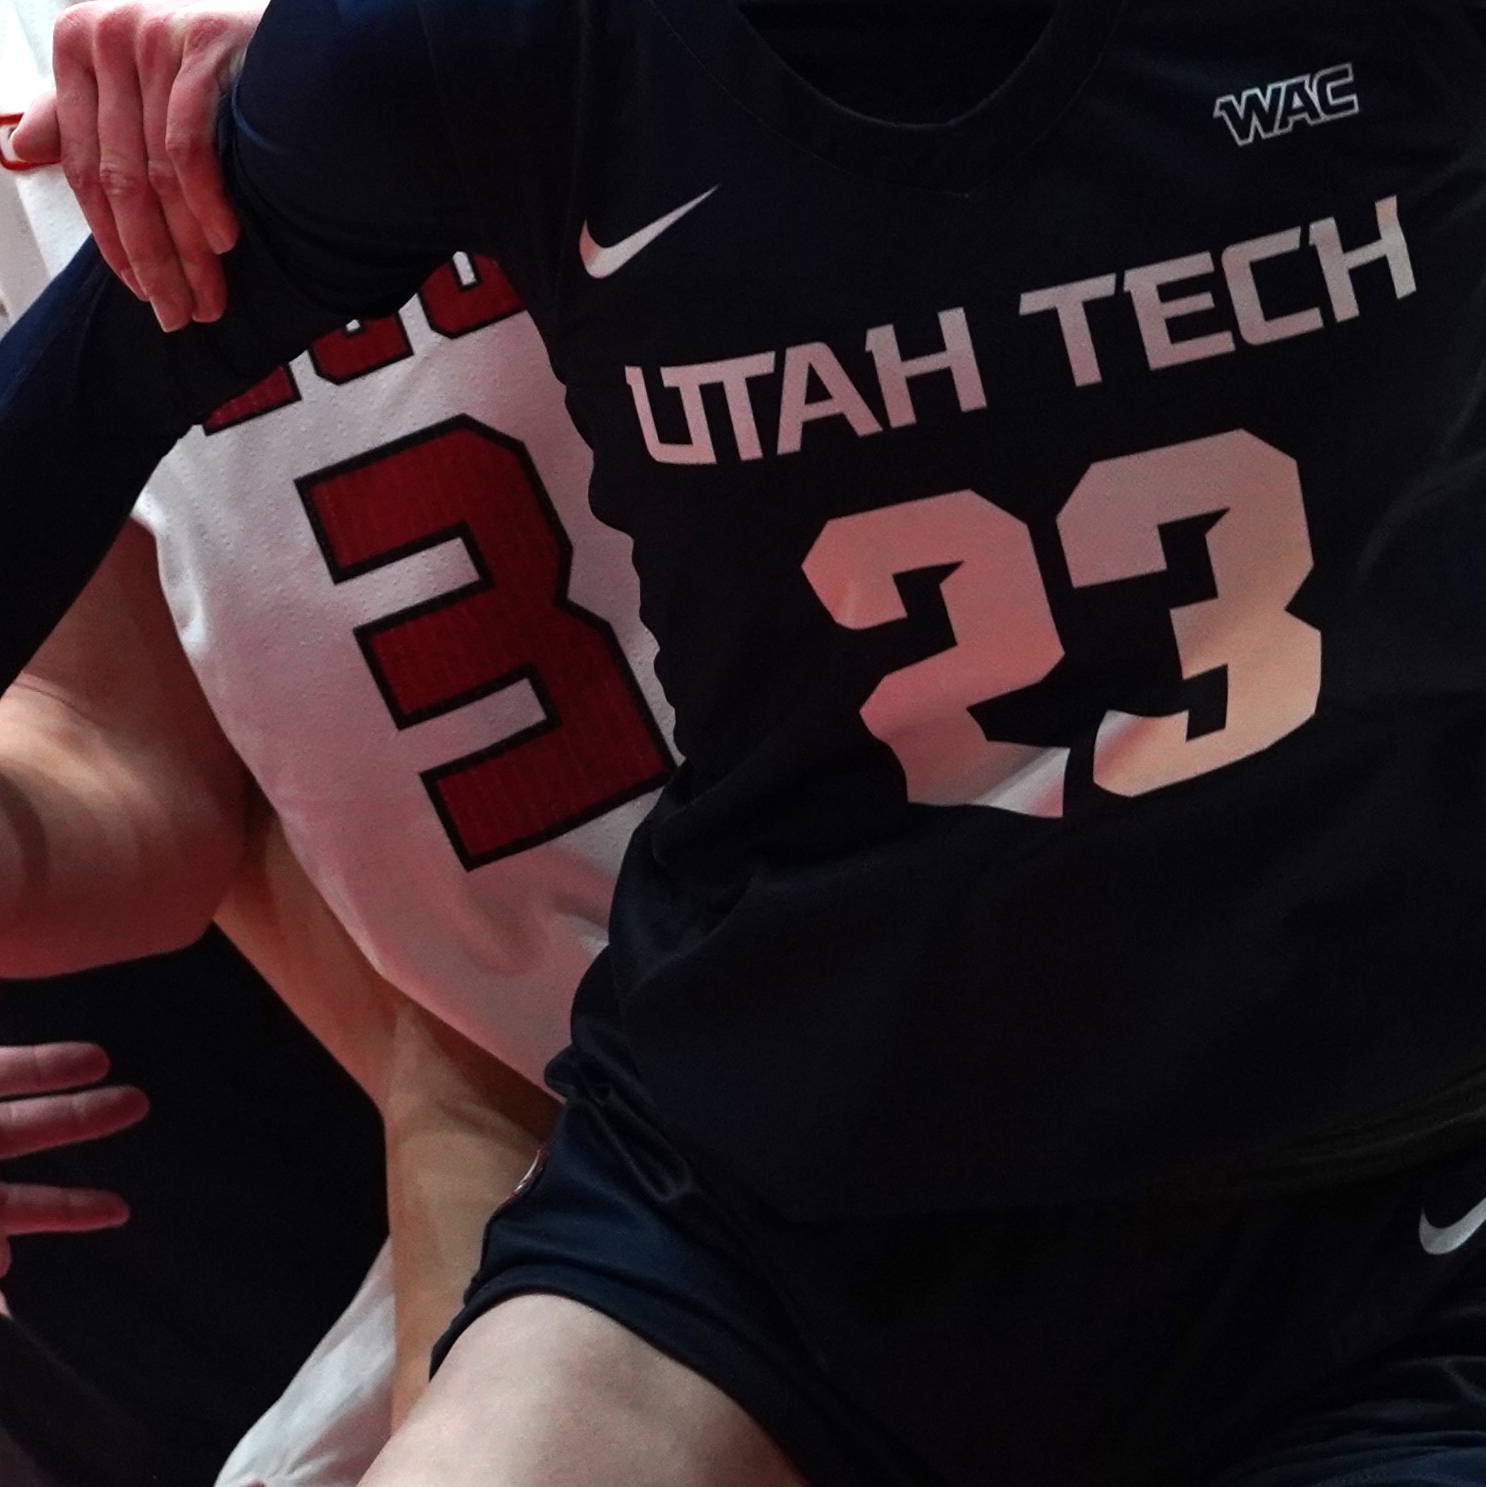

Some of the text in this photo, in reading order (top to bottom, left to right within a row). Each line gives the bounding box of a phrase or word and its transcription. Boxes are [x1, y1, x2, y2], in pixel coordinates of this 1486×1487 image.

[1213, 62, 1359, 149] WAC
[624, 306, 987, 466] UTAH
[1019, 195, 1417, 388] TECH
[294, 414, 686, 871] 3
[801, 428, 1322, 818] 23
